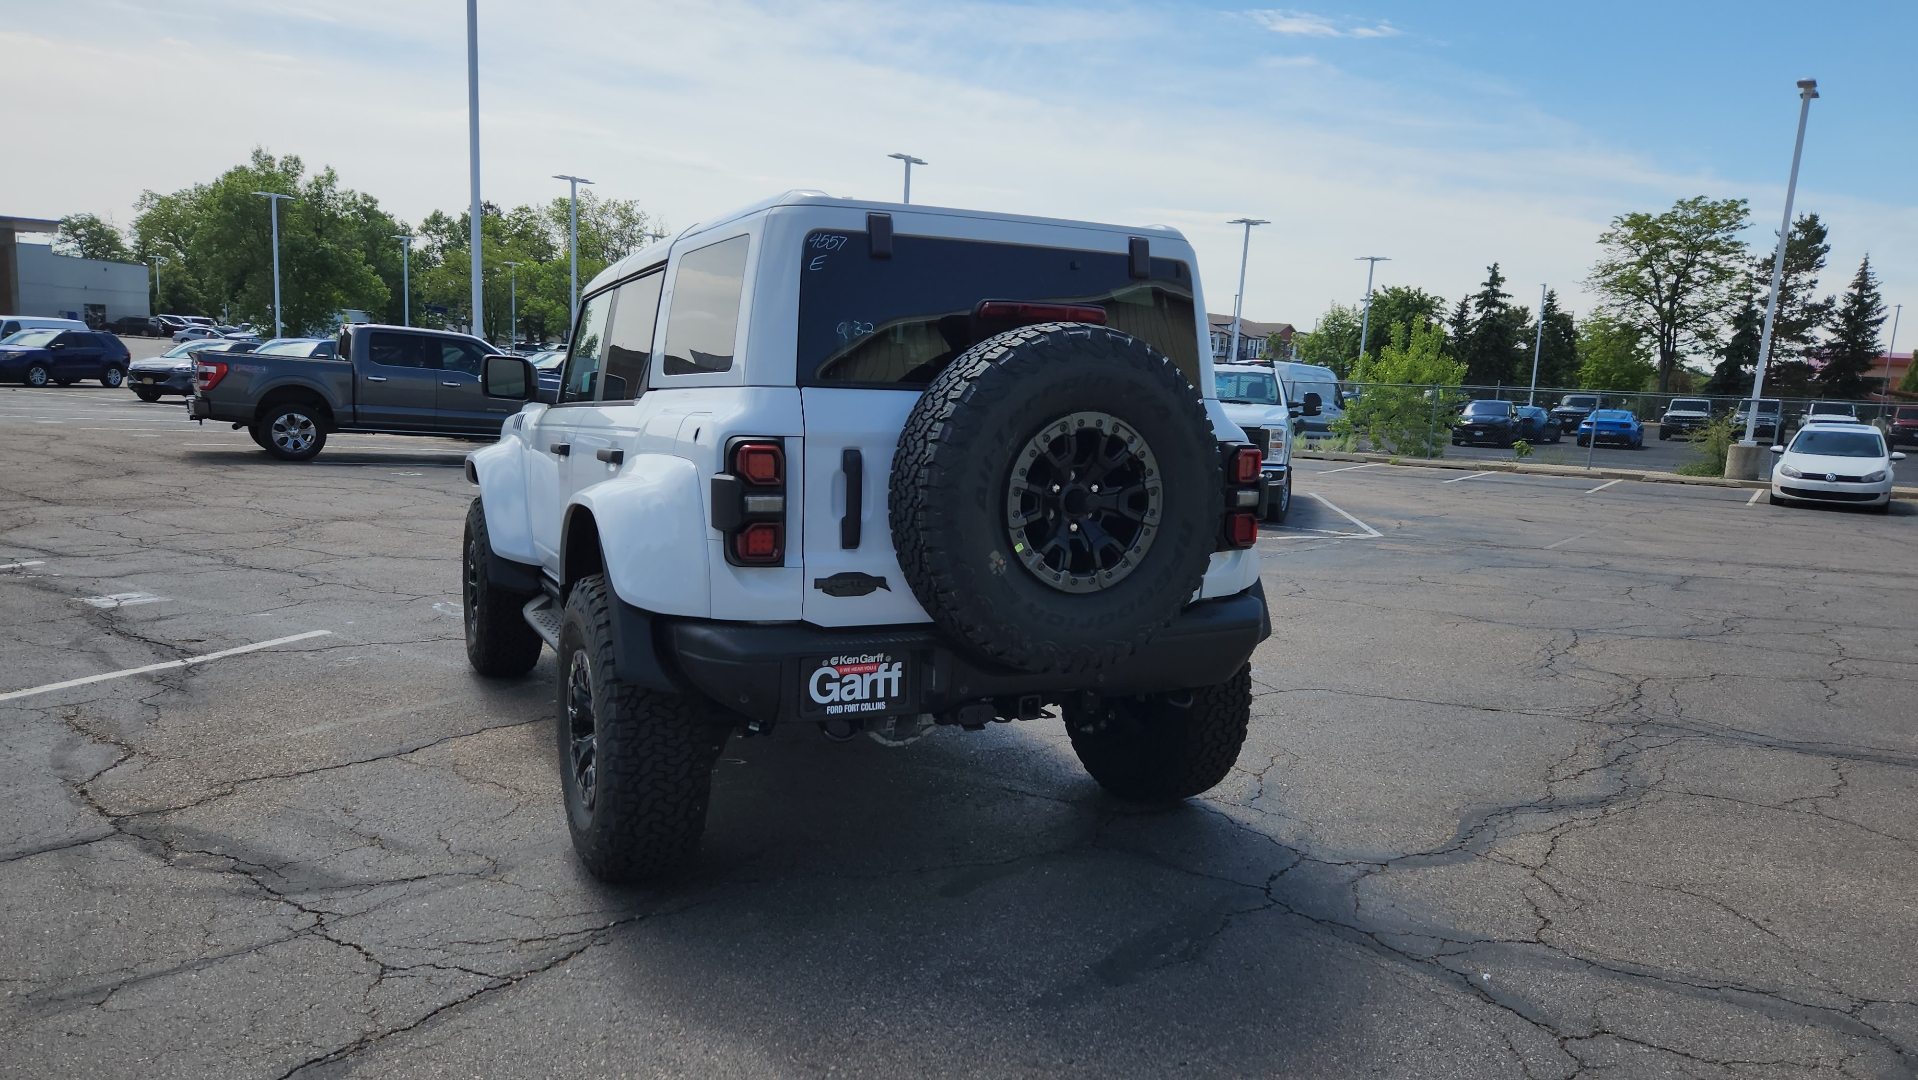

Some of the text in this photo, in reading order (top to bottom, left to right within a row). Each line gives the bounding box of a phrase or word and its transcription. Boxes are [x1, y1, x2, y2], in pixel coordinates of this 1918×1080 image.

[809, 233, 848, 251] 4557
[809, 254, 828, 271] E
[840, 653, 884, 665] Ken Garff
[809, 662, 902, 704] Garff
[827, 701, 886, 715] FORD FORT COLLINS
